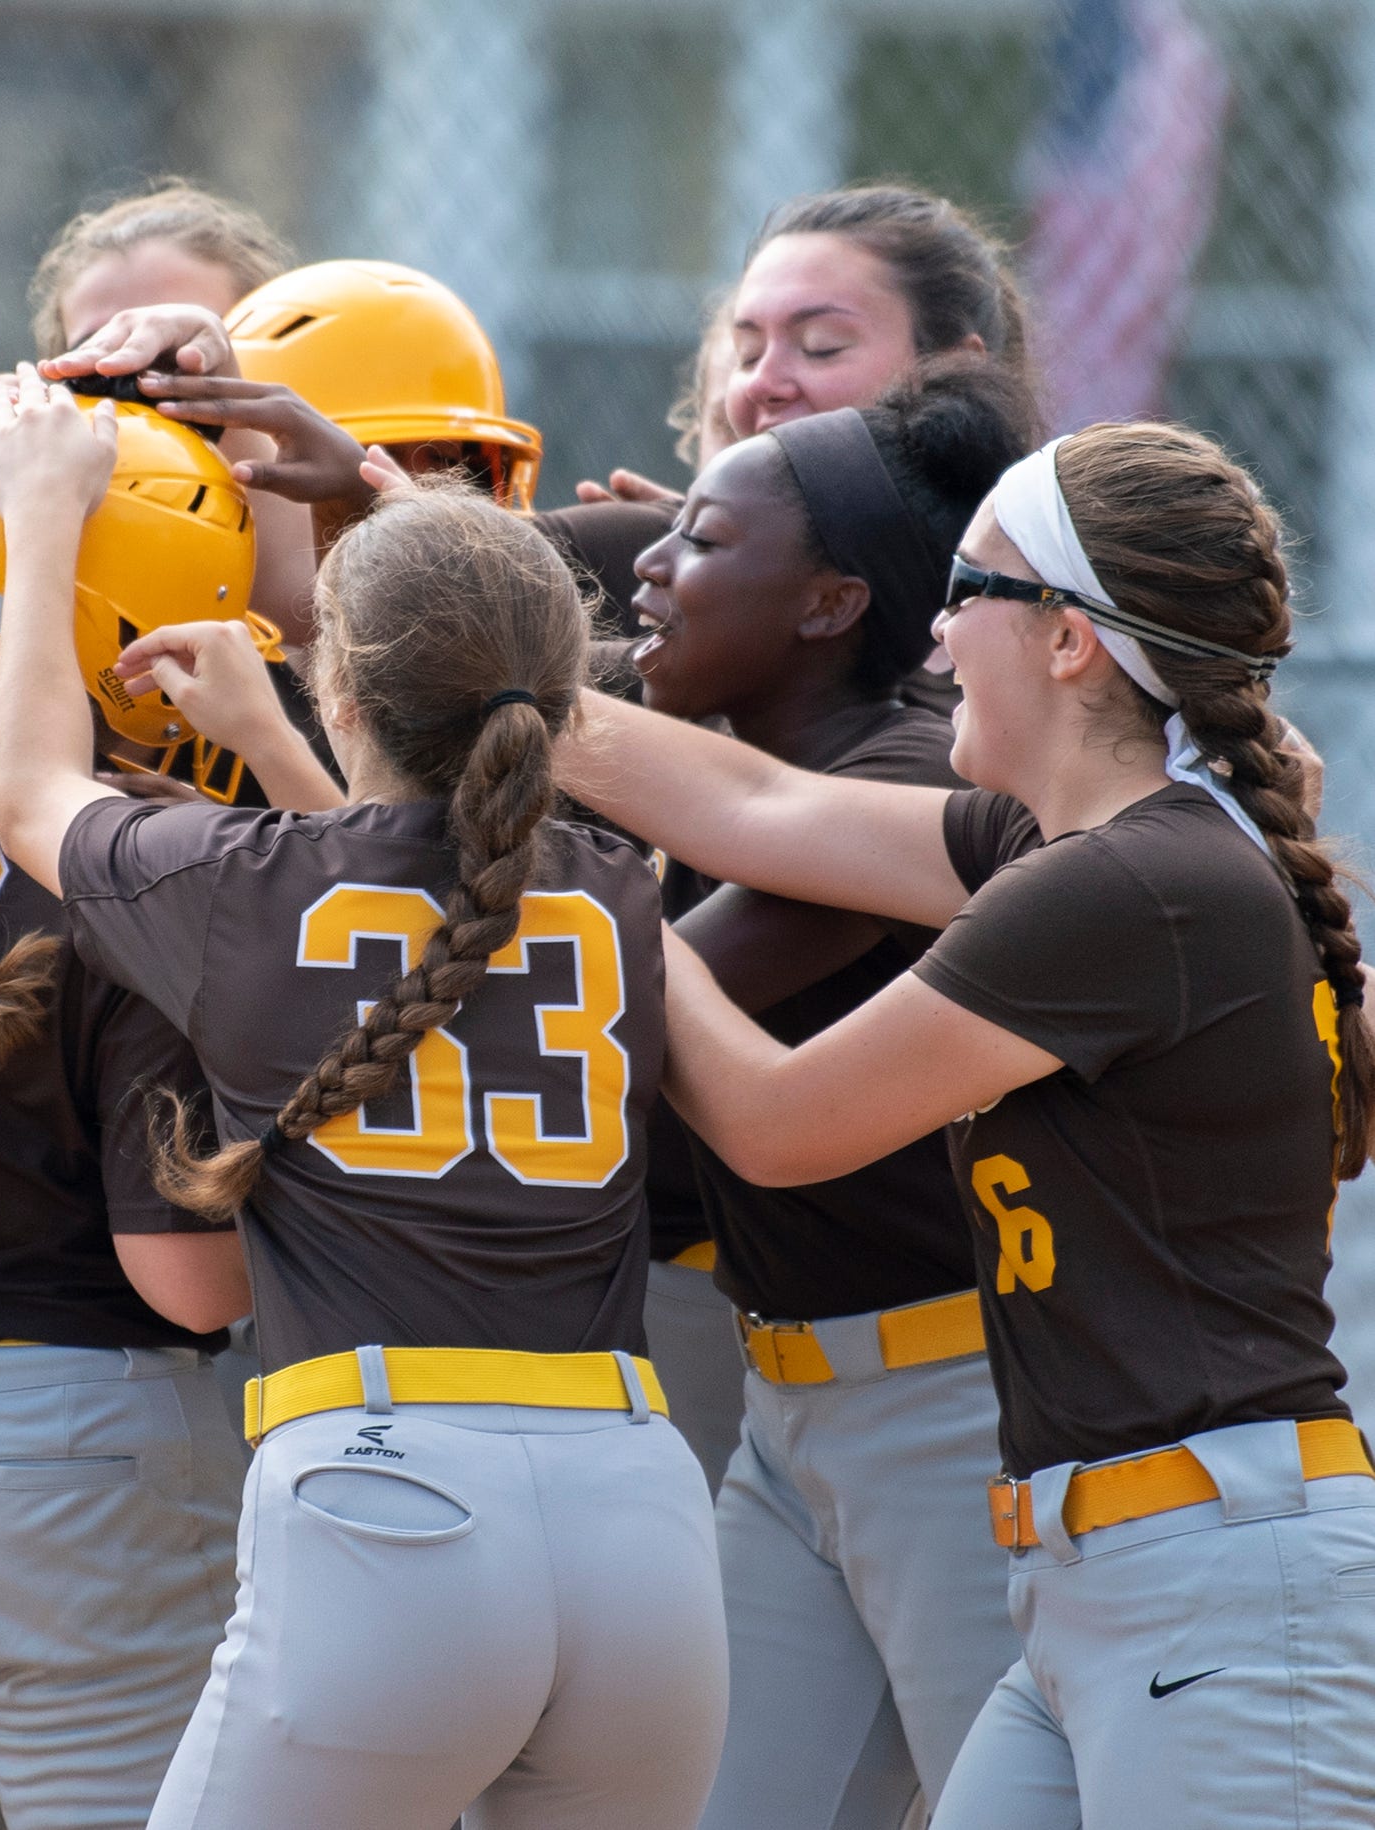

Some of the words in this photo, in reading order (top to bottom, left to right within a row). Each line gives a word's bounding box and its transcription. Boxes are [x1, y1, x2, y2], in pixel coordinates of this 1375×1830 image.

[98, 667, 136, 713] schutt
[296, 882, 629, 1189] 33
[344, 1447, 405, 1460] EASTON
